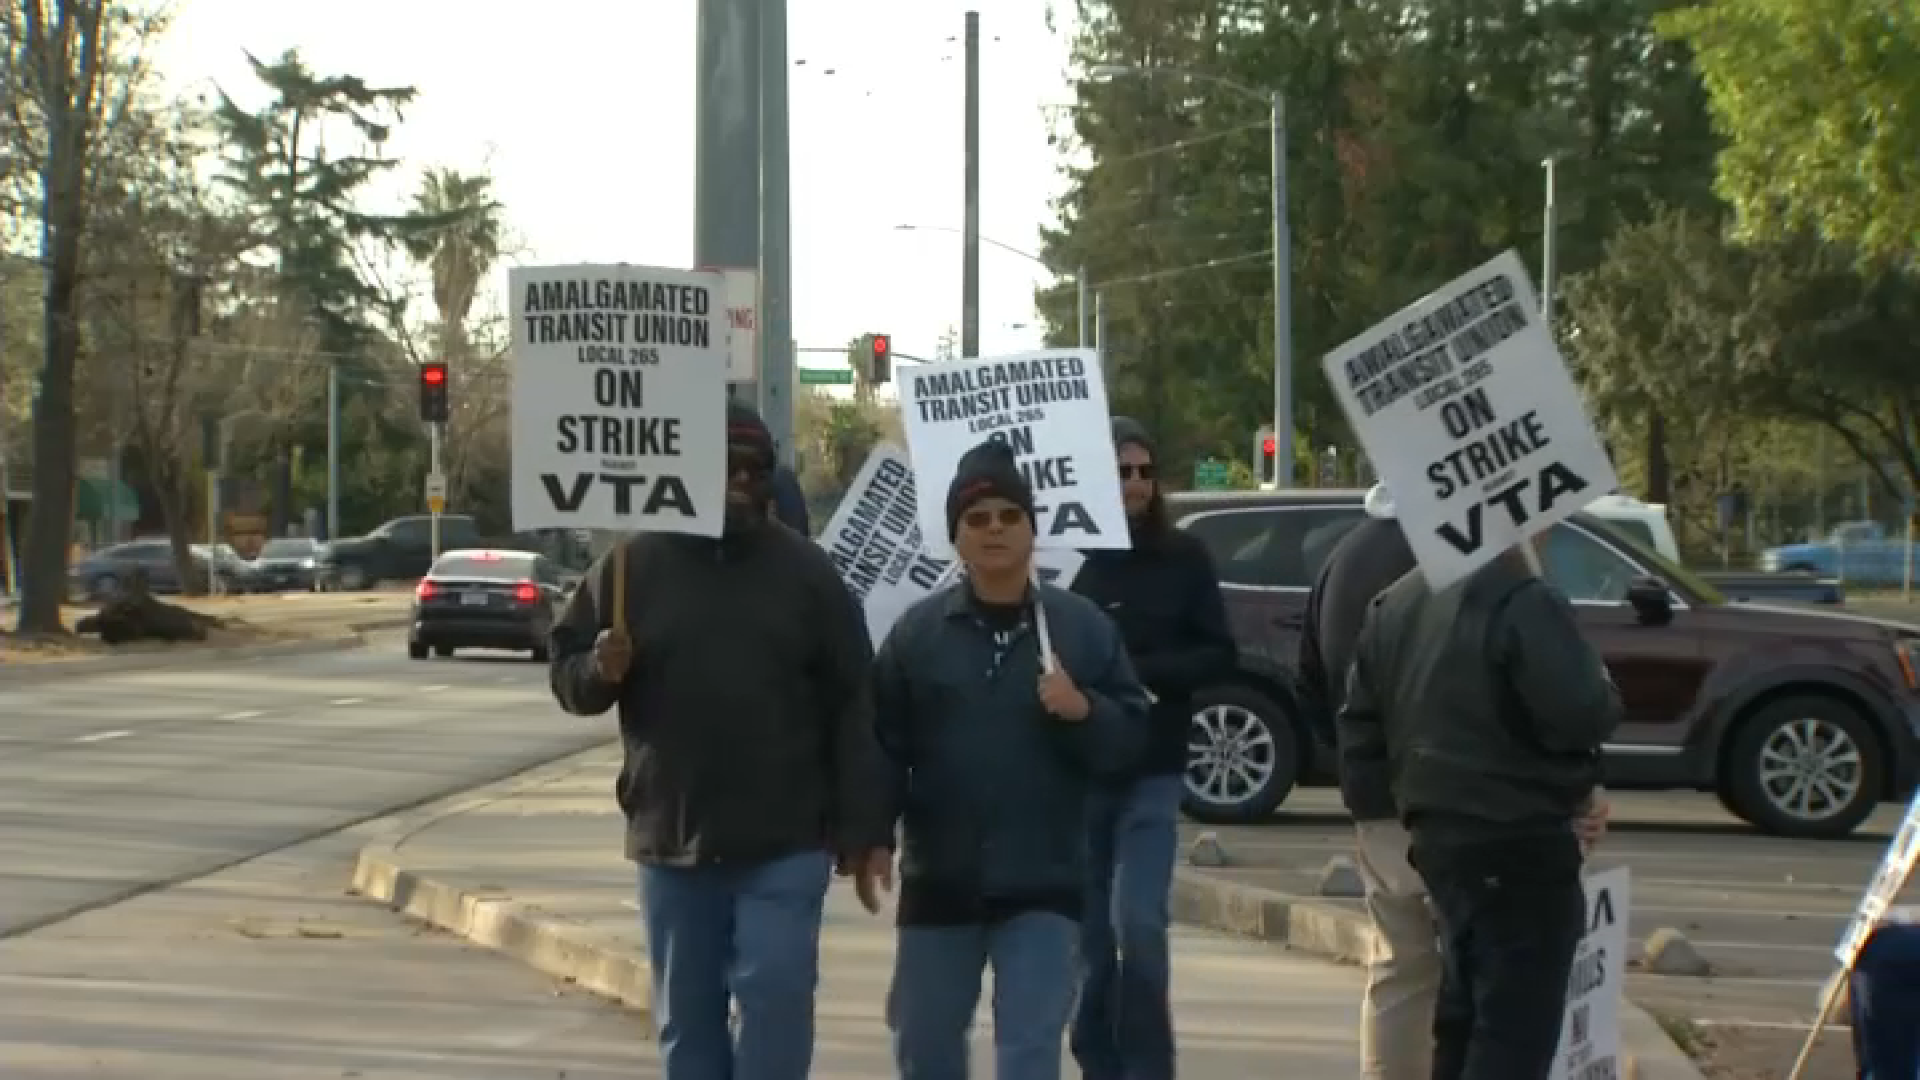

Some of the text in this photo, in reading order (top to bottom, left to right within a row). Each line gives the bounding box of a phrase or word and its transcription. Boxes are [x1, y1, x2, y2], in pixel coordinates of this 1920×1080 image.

[525, 279, 709, 315] AMALGAMATED
[525, 312, 709, 348] TRANSIT UNION
[578, 346, 659, 365] LOCAL 265
[594, 368, 643, 408] ON
[914, 357, 1085, 398] AMALGAMATED
[915, 378, 1089, 422] TRANSIT UNION
[1440, 386, 1496, 439] ON
[557, 415, 681, 456] STRIKE
[968, 413, 1013, 433] LOCAL
[1021, 455, 1077, 491] IKE
[1426, 408, 1551, 500] STRIKE
[540, 472, 697, 518] VTA
[832, 458, 905, 572] ALGAMATED
[1434, 460, 1590, 555] VTA
